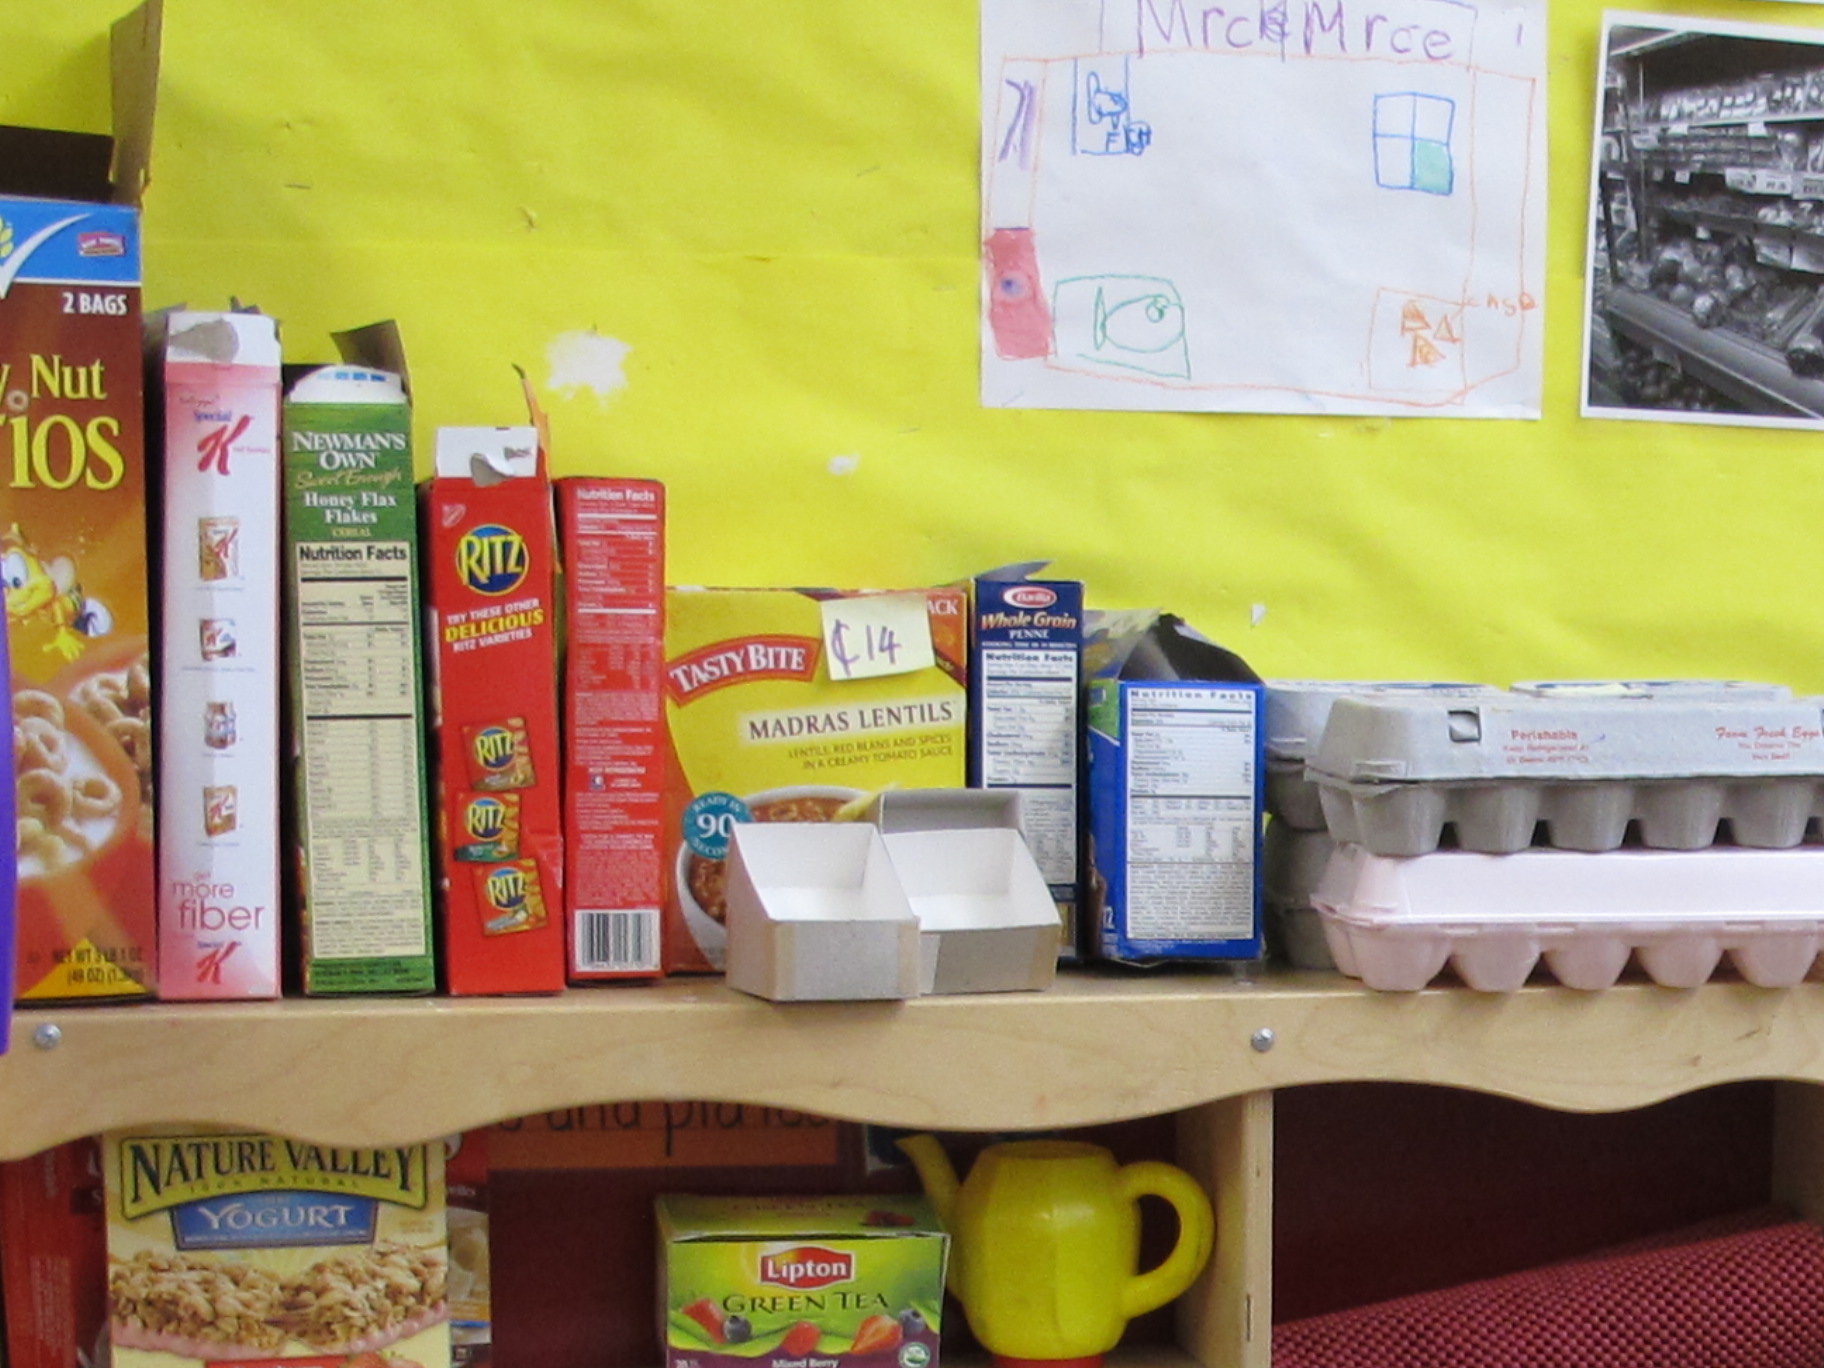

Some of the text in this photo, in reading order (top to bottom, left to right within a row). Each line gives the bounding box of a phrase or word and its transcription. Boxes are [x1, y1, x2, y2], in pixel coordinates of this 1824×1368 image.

[62, 292, 127, 315] 2 BAGS
[31, 355, 106, 399] Nut
[319, 450, 376, 470] OWN
[304, 491, 397, 509] Honey Flax
[325, 509, 378, 524] Flakes
[300, 545, 408, 561] Nutrition Facts
[460, 534, 523, 586] RITZ
[446, 609, 544, 642] DELICIOUS
[982, 611, 1078, 630] Whole Grain
[669, 644, 807, 692] TASTY BITE
[749, 702, 953, 741] MADRAS LENTILS
[475, 728, 514, 763] RITZ
[466, 803, 506, 834] RITZ
[172, 879, 235, 899] more
[488, 870, 526, 906] RITZ
[178, 901, 264, 931] fiber
[129, 1138, 414, 1203] NATURE VALLEY
[200, 1203, 355, 1230] YOGURT
[768, 1259, 847, 1283] Lipton
[722, 1291, 890, 1314] GREEN TEA
